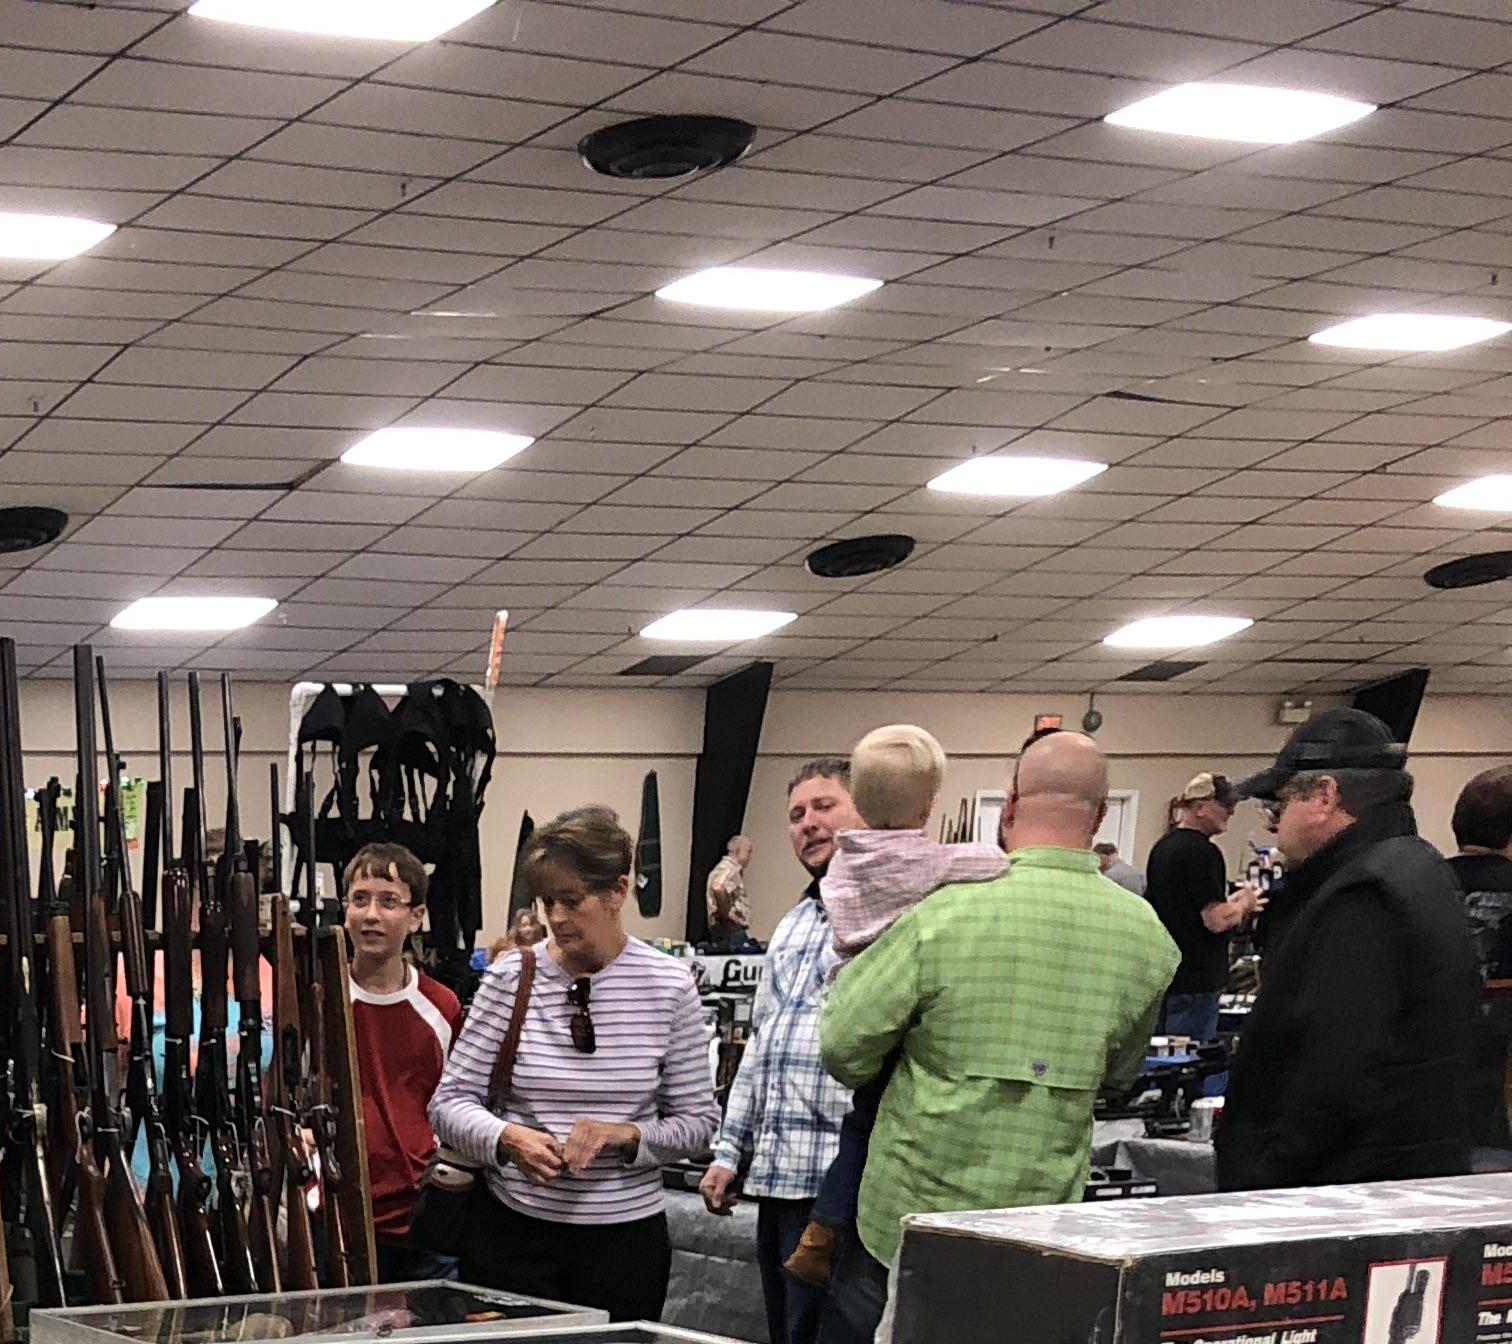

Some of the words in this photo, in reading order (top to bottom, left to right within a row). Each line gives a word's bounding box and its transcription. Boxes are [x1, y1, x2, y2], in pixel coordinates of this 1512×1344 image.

[721, 959, 763, 986] Gu
[1165, 1268, 1226, 1287] Models
[1161, 1286, 1258, 1316] M510A,
[1263, 1277, 1348, 1306] M511A
